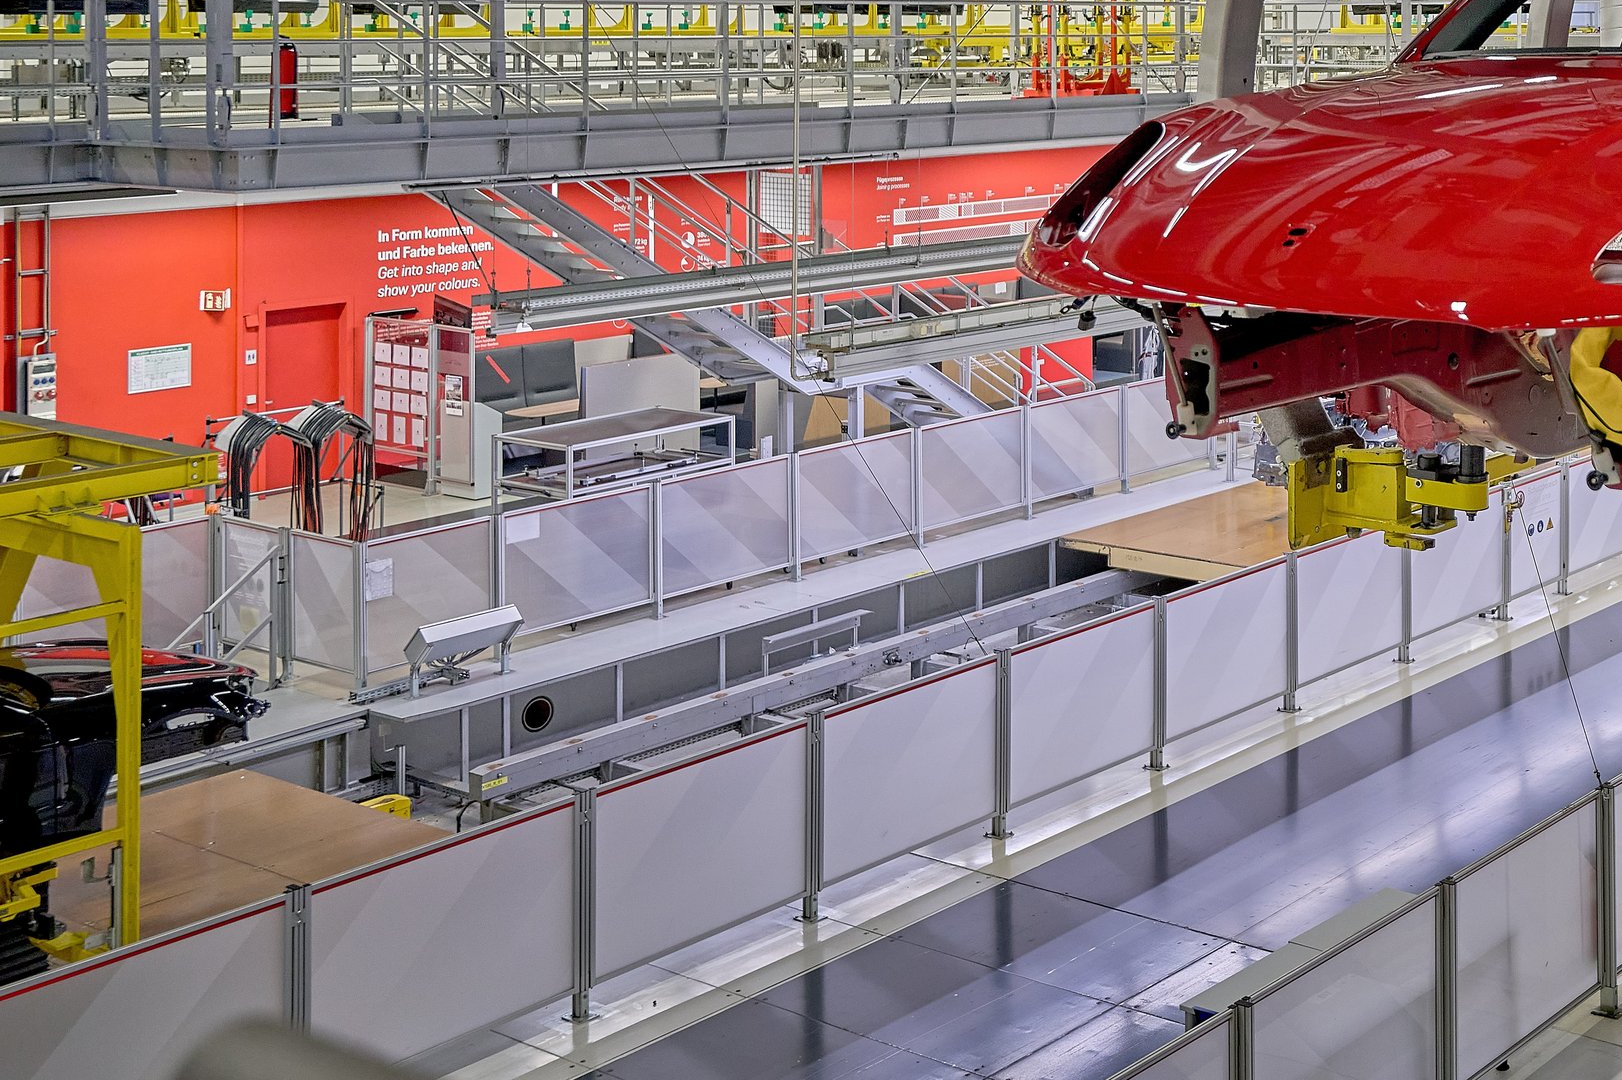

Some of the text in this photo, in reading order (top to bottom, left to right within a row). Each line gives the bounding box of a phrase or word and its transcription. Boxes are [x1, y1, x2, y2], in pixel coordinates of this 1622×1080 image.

[377, 225, 474, 242] In Form kommen
[377, 240, 495, 261] und Farbe bekennen.
[377, 256, 483, 279] Get into shape and
[377, 277, 481, 298] show your colours.
